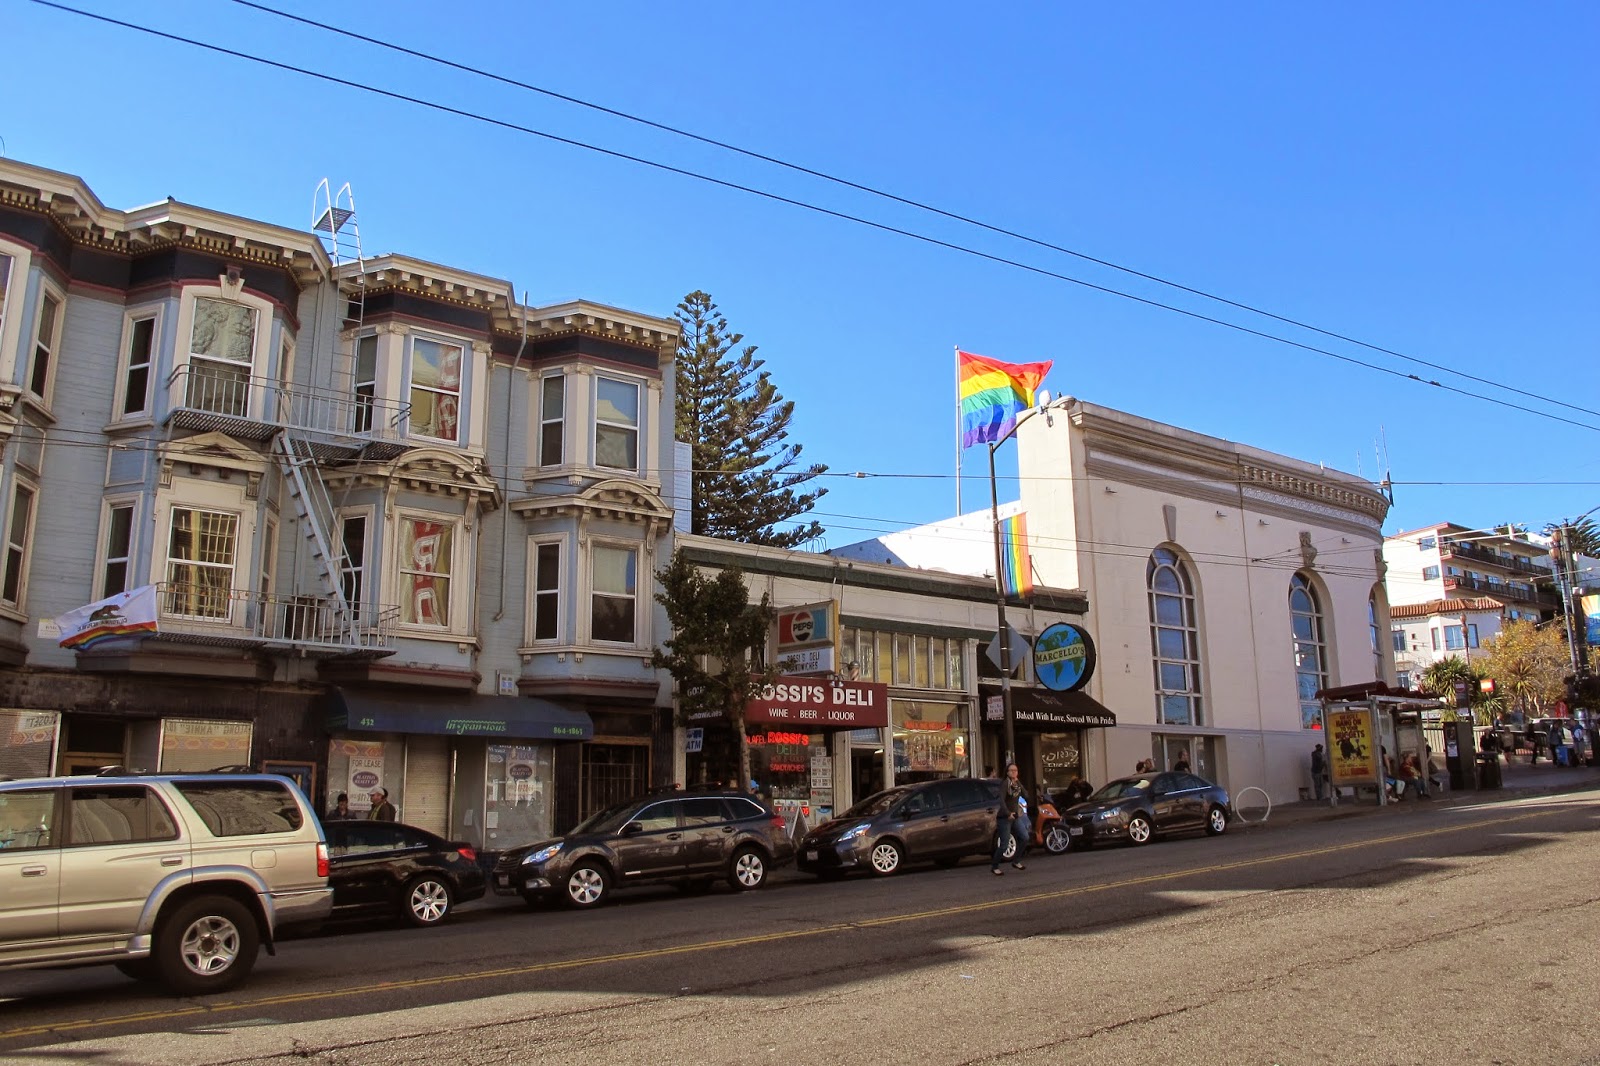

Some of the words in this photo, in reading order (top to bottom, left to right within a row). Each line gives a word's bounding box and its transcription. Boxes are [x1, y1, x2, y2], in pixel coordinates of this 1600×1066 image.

[793, 621, 813, 632] PEPSI
[809, 651, 820, 662] DELI
[1036, 646, 1085, 662] MARCELLO'S
[833, 687, 873, 706] DELI
[769, 708, 789, 718] WINE
[799, 709, 818, 719] BEER
[828, 711, 855, 720] LIQUOR
[1016, 711, 1034, 720] Baked
[1035, 712, 1049, 721] With
[1050, 713, 1066, 722] Love,
[1066, 714, 1084, 723] Served
[1085, 715, 1099, 724] With
[1100, 716, 1114, 725] Pride
[361, 718, 374, 726] 432
[686, 740, 701, 750] ATM
[352, 759, 363, 767] FOR
[364, 760, 382, 768] LEASE
